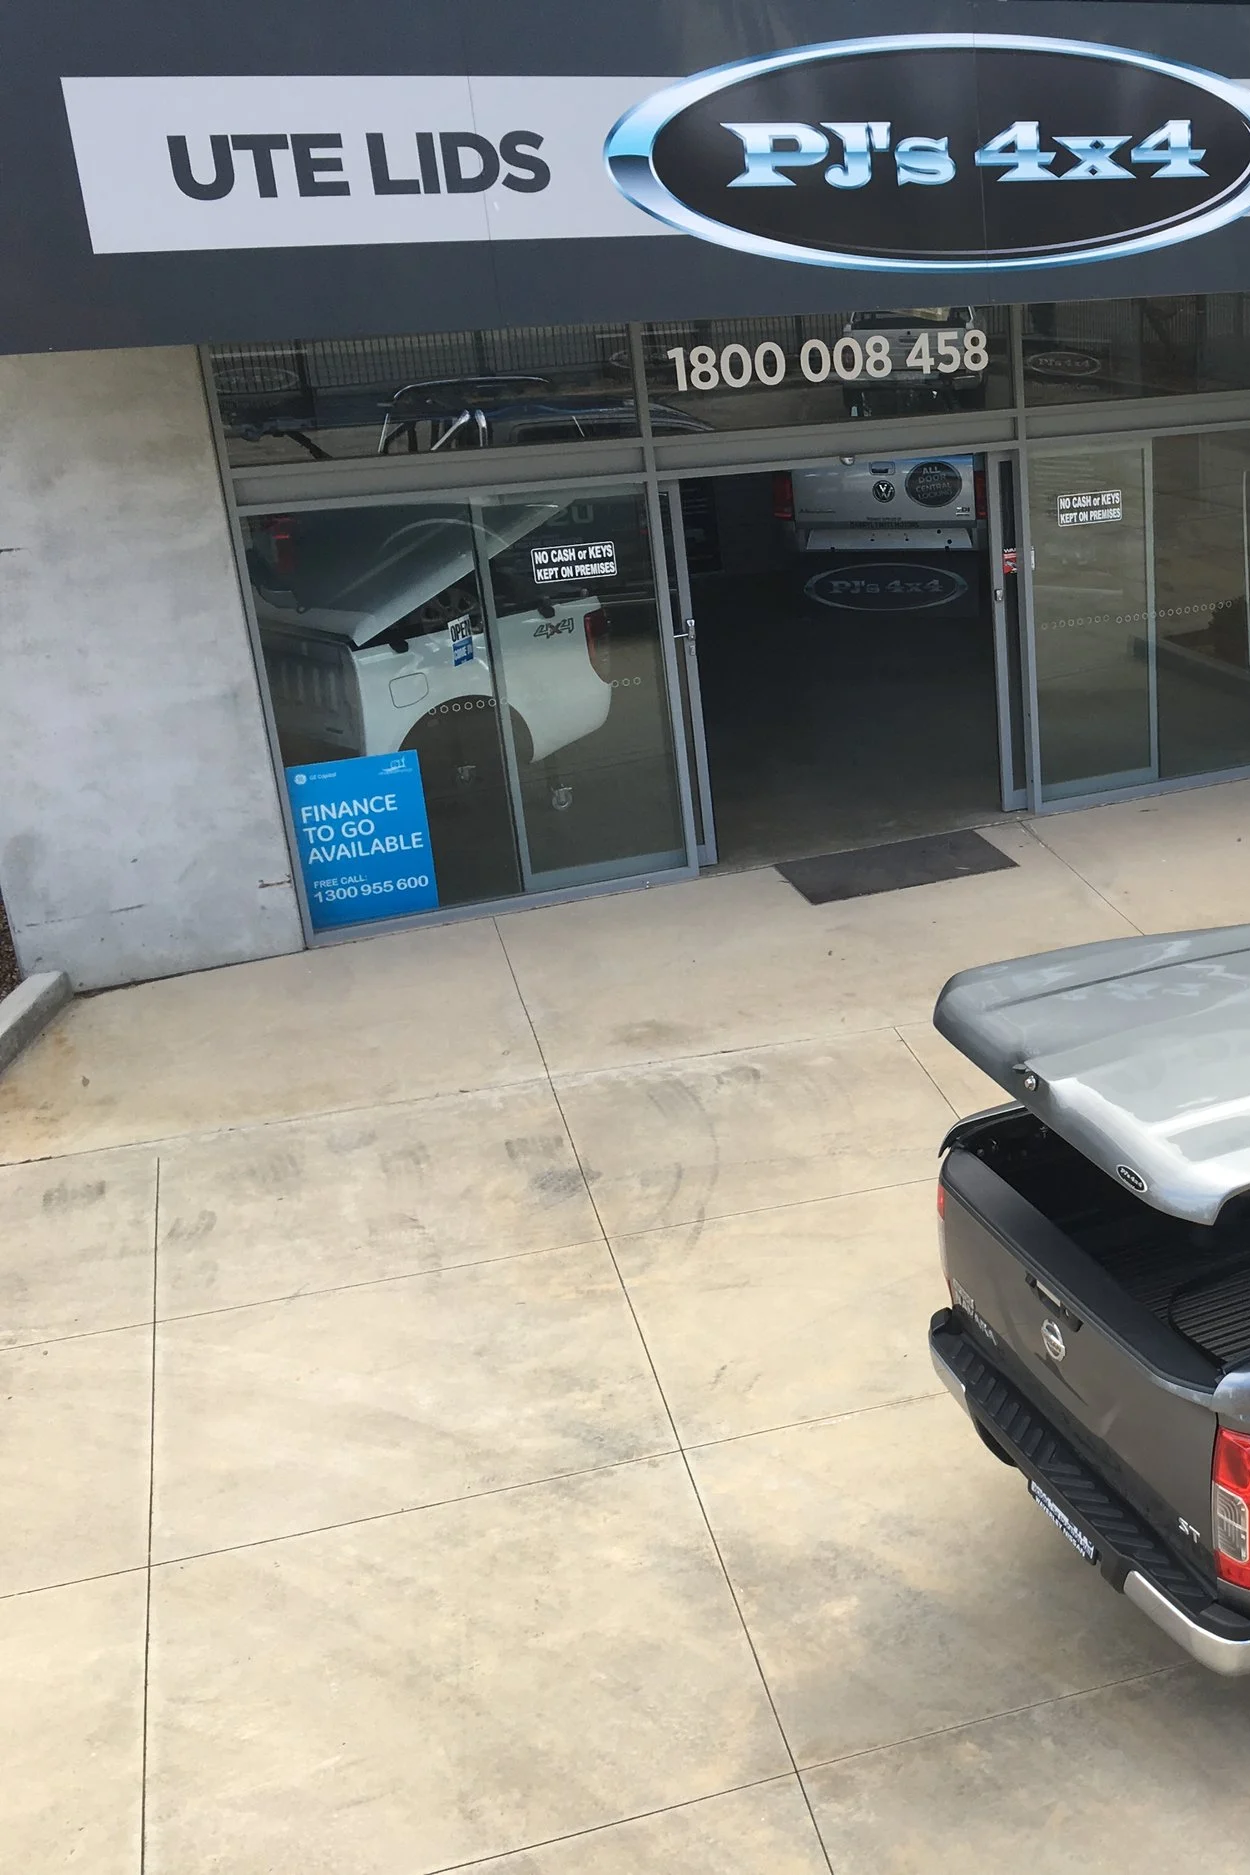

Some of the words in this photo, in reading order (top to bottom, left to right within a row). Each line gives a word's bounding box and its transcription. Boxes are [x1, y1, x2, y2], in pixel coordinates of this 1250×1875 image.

[719, 121, 956, 189] PJ's
[975, 119, 1210, 183] 4x4
[167, 132, 351, 201] UTE
[368, 130, 551, 197] LIDS
[667, 340, 787, 392] 1800
[800, 335, 893, 384] 008
[905, 329, 989, 374] 458
[918, 474, 947, 484] DOOR
[922, 466, 941, 475] ALL
[915, 482, 952, 493] CENTRAL
[1060, 498, 1070, 509] NO
[1072, 496, 1091, 508] CASH
[1093, 497, 1100, 506] or
[1101, 493, 1120, 505] KEYS
[1060, 512, 1078, 524] KEPT
[1078, 511, 1088, 522] ON
[1089, 508, 1120, 520] PREMISES
[534, 551, 549, 564] NO
[550, 548, 576, 563] CASH
[577, 550, 587, 560] or
[588, 544, 613, 559] KEYS
[537, 567, 559, 581] KEPT
[560, 566, 573, 578] ON
[574, 562, 615, 577] PREMISES
[829, 580, 880, 594] PJ's
[885, 579, 943, 593] 4x4
[450, 620, 472, 643] OPEN
[533, 618, 574, 639] 4x4
[301, 794, 398, 824] FINANCE
[303, 825, 335, 844] TO
[341, 818, 375, 839] GO
[308, 832, 424, 864] AVAILABLE
[313, 878, 338, 888] FREE
[313, 885, 358, 903] 1300
[360, 880, 394, 896] 955
[396, 875, 429, 891] 600
[1178, 1516, 1201, 1544] ST
